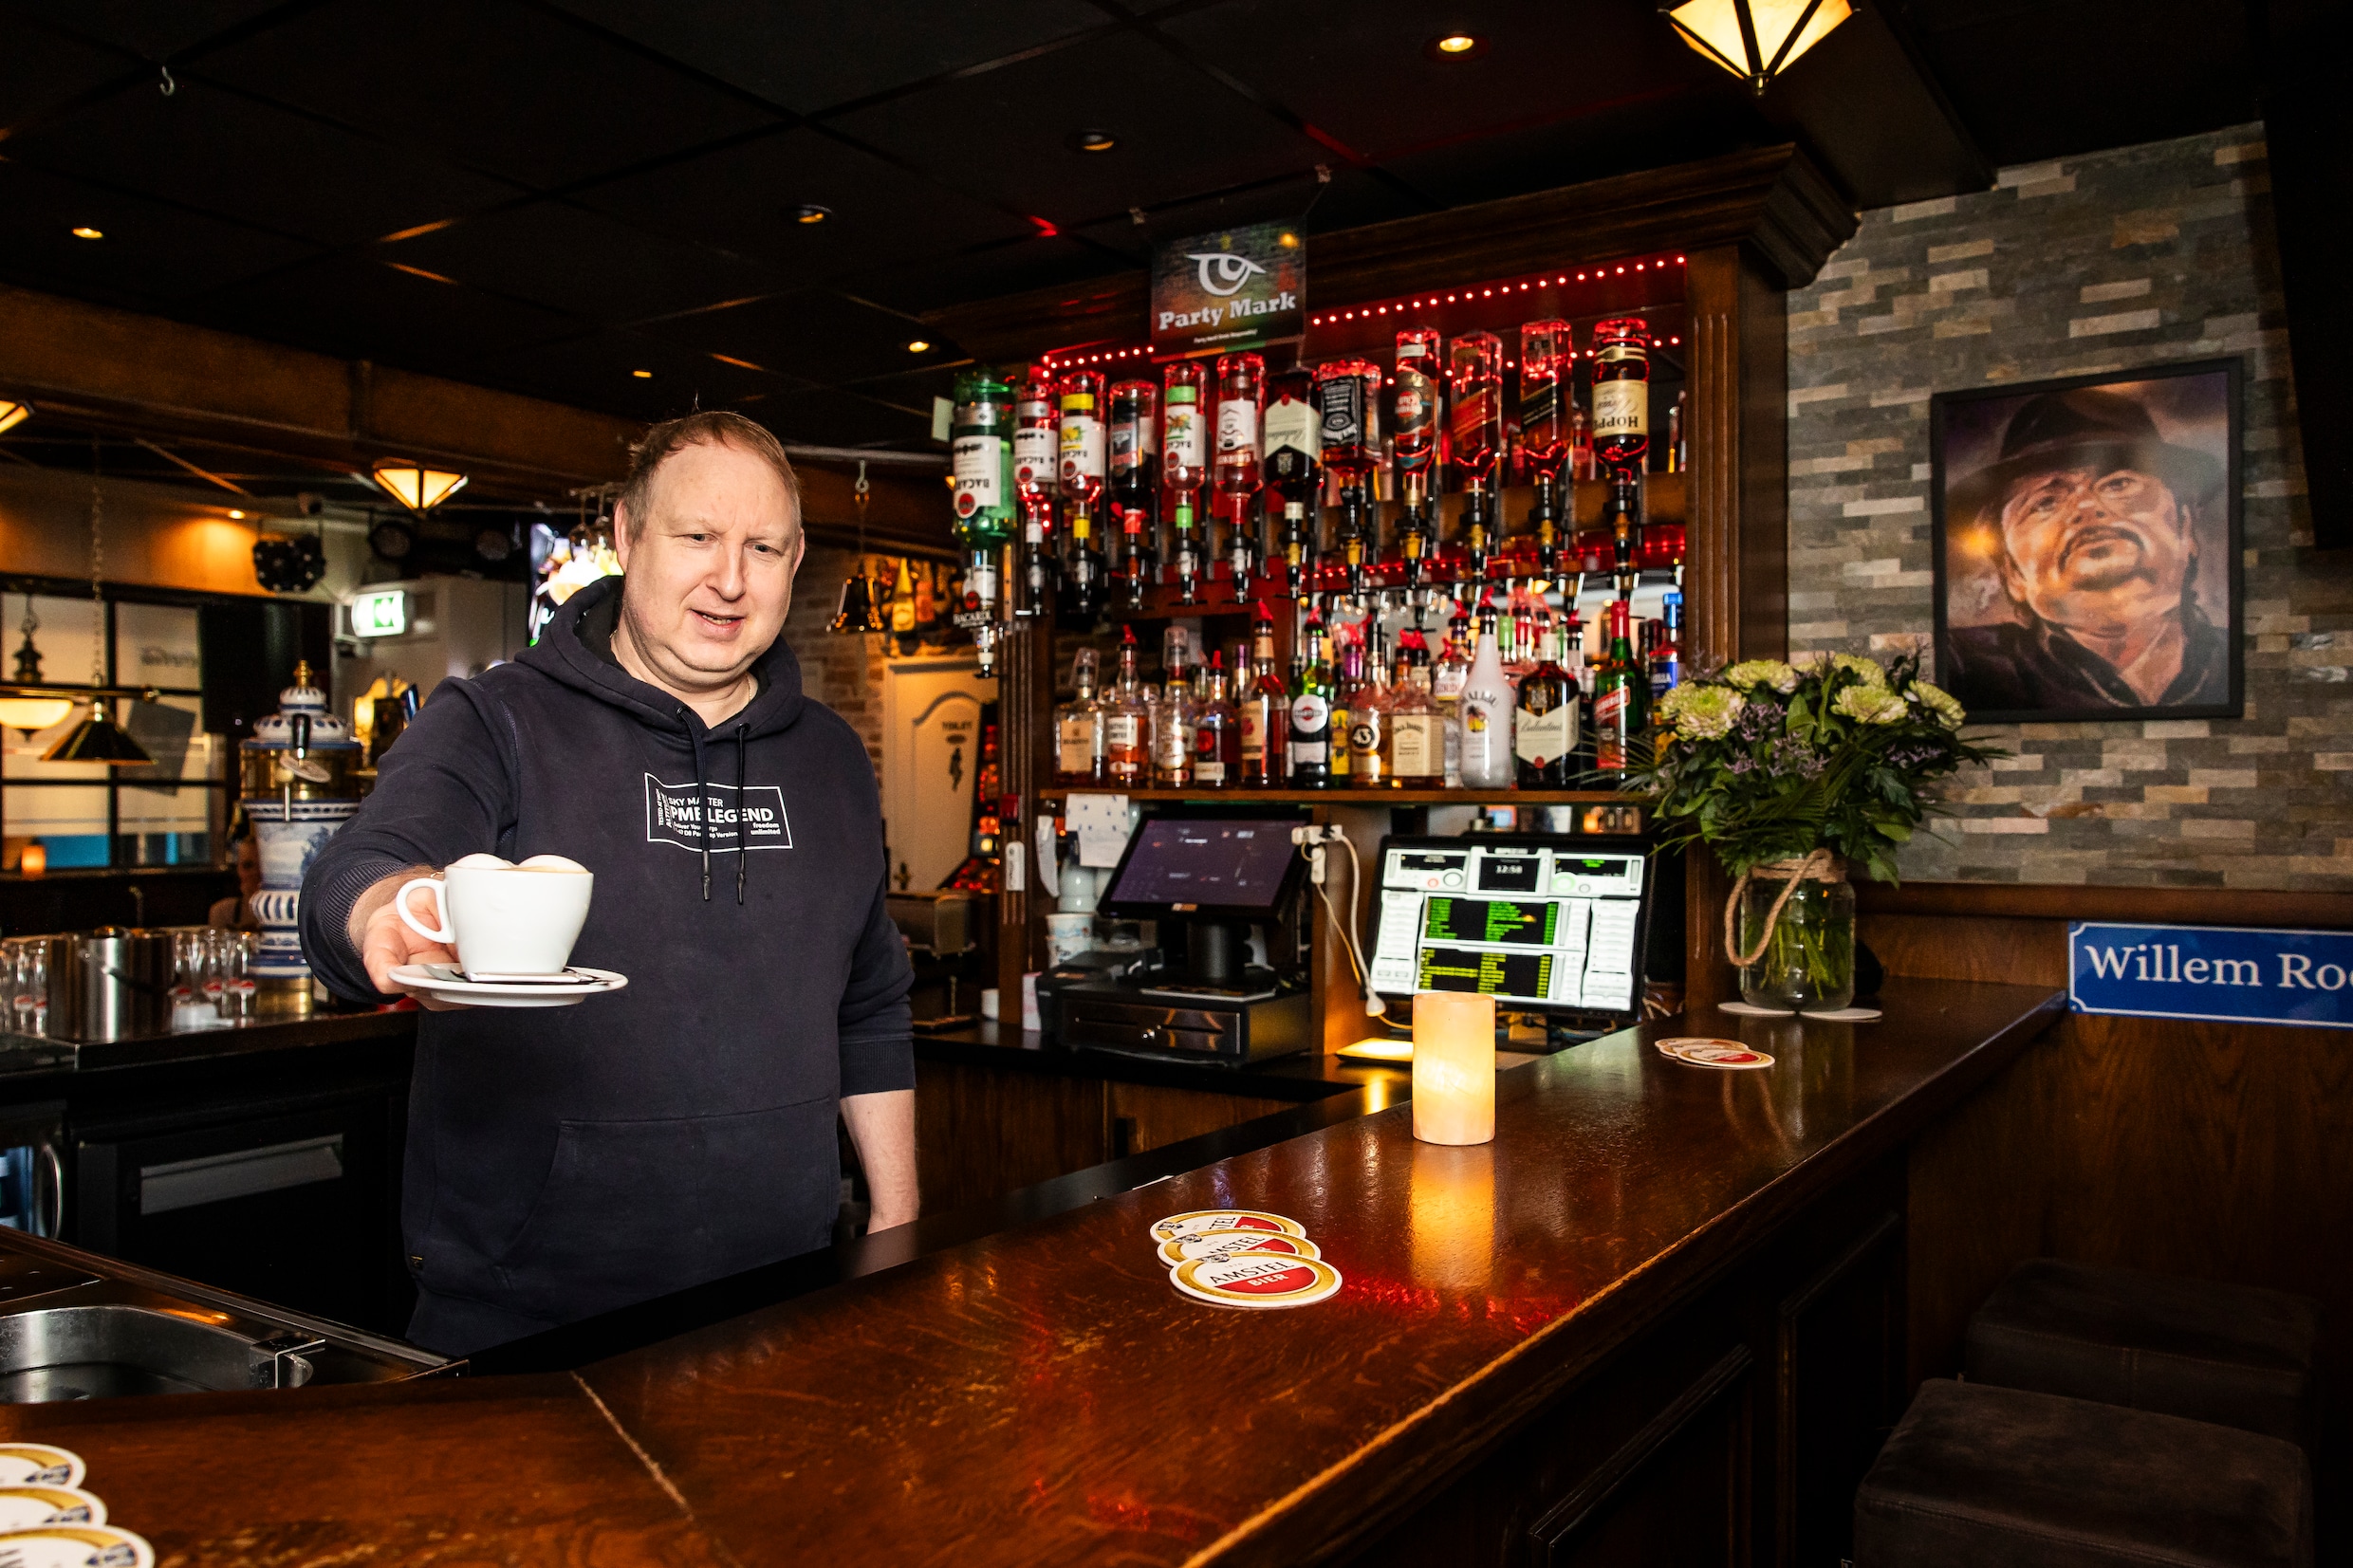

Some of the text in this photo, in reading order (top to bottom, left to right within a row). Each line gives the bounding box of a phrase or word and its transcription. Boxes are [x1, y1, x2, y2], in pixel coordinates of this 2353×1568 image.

[1158, 292, 1296, 331] Party Mark
[668, 797, 685, 806] SKY
[670, 805, 773, 823] PME LEGEND
[2084, 944, 2353, 991] Willem Ro
[1209, 1261, 1295, 1284] AMSTEL
[1247, 1273, 1289, 1286] BIER
